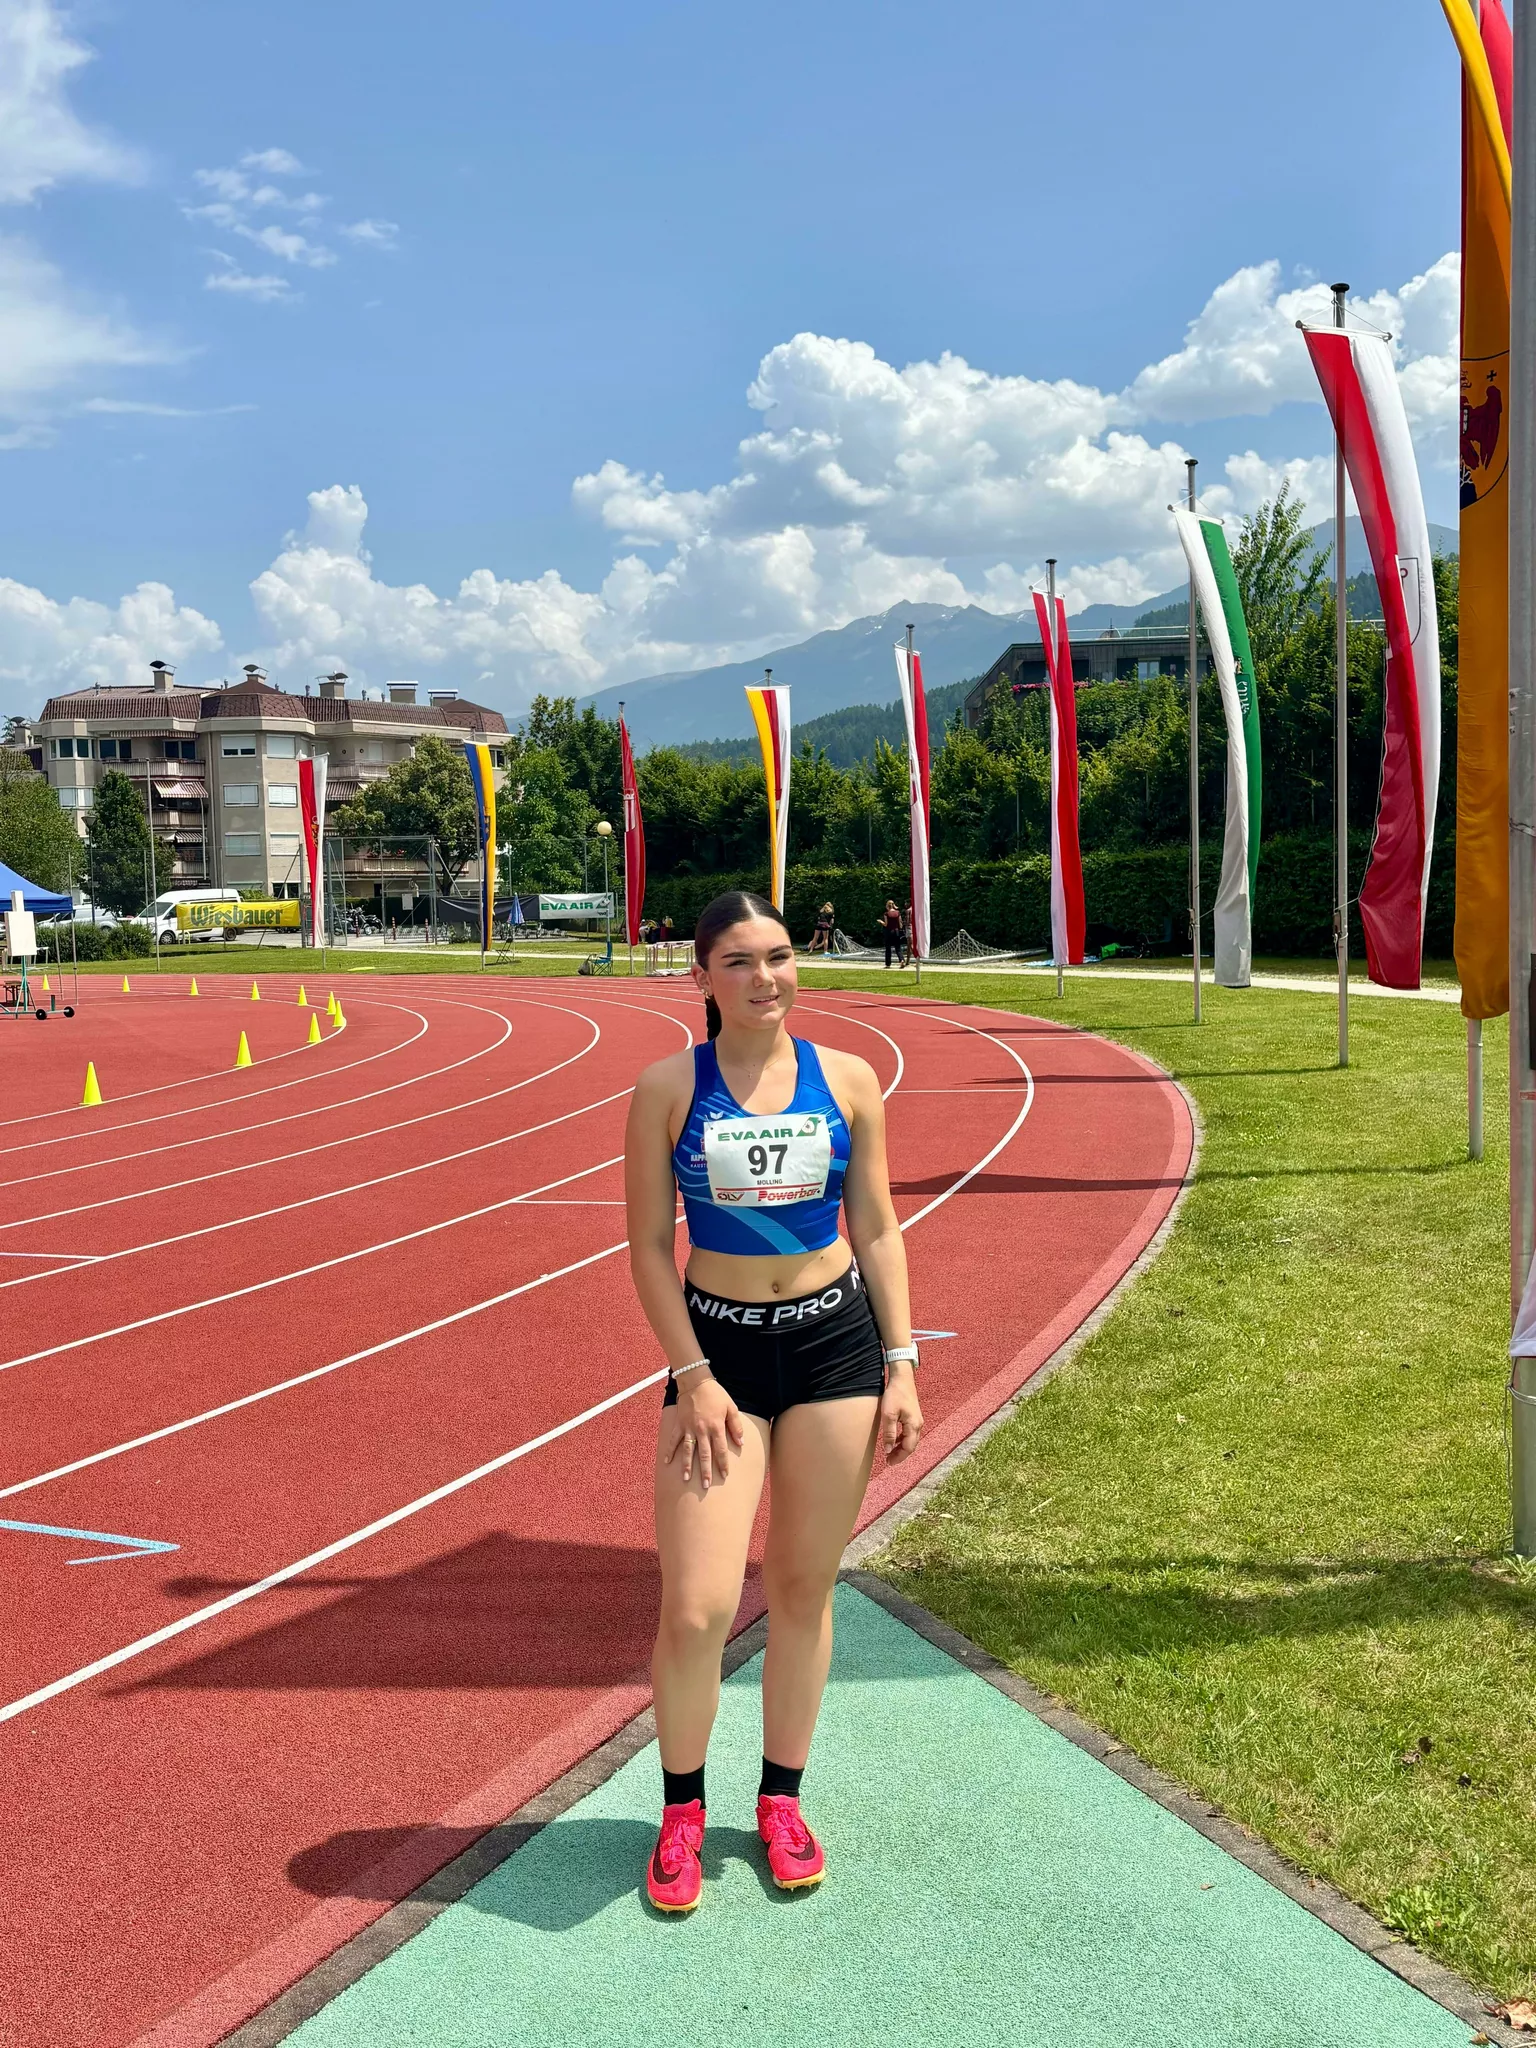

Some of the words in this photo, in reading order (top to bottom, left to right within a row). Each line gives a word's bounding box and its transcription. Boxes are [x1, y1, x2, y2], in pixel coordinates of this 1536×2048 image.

[191, 905, 283, 926] Wiesbauer
[748, 1144, 788, 1176] 97
[689, 1293, 766, 1325] NIKE
[772, 1288, 843, 1325] PRO
